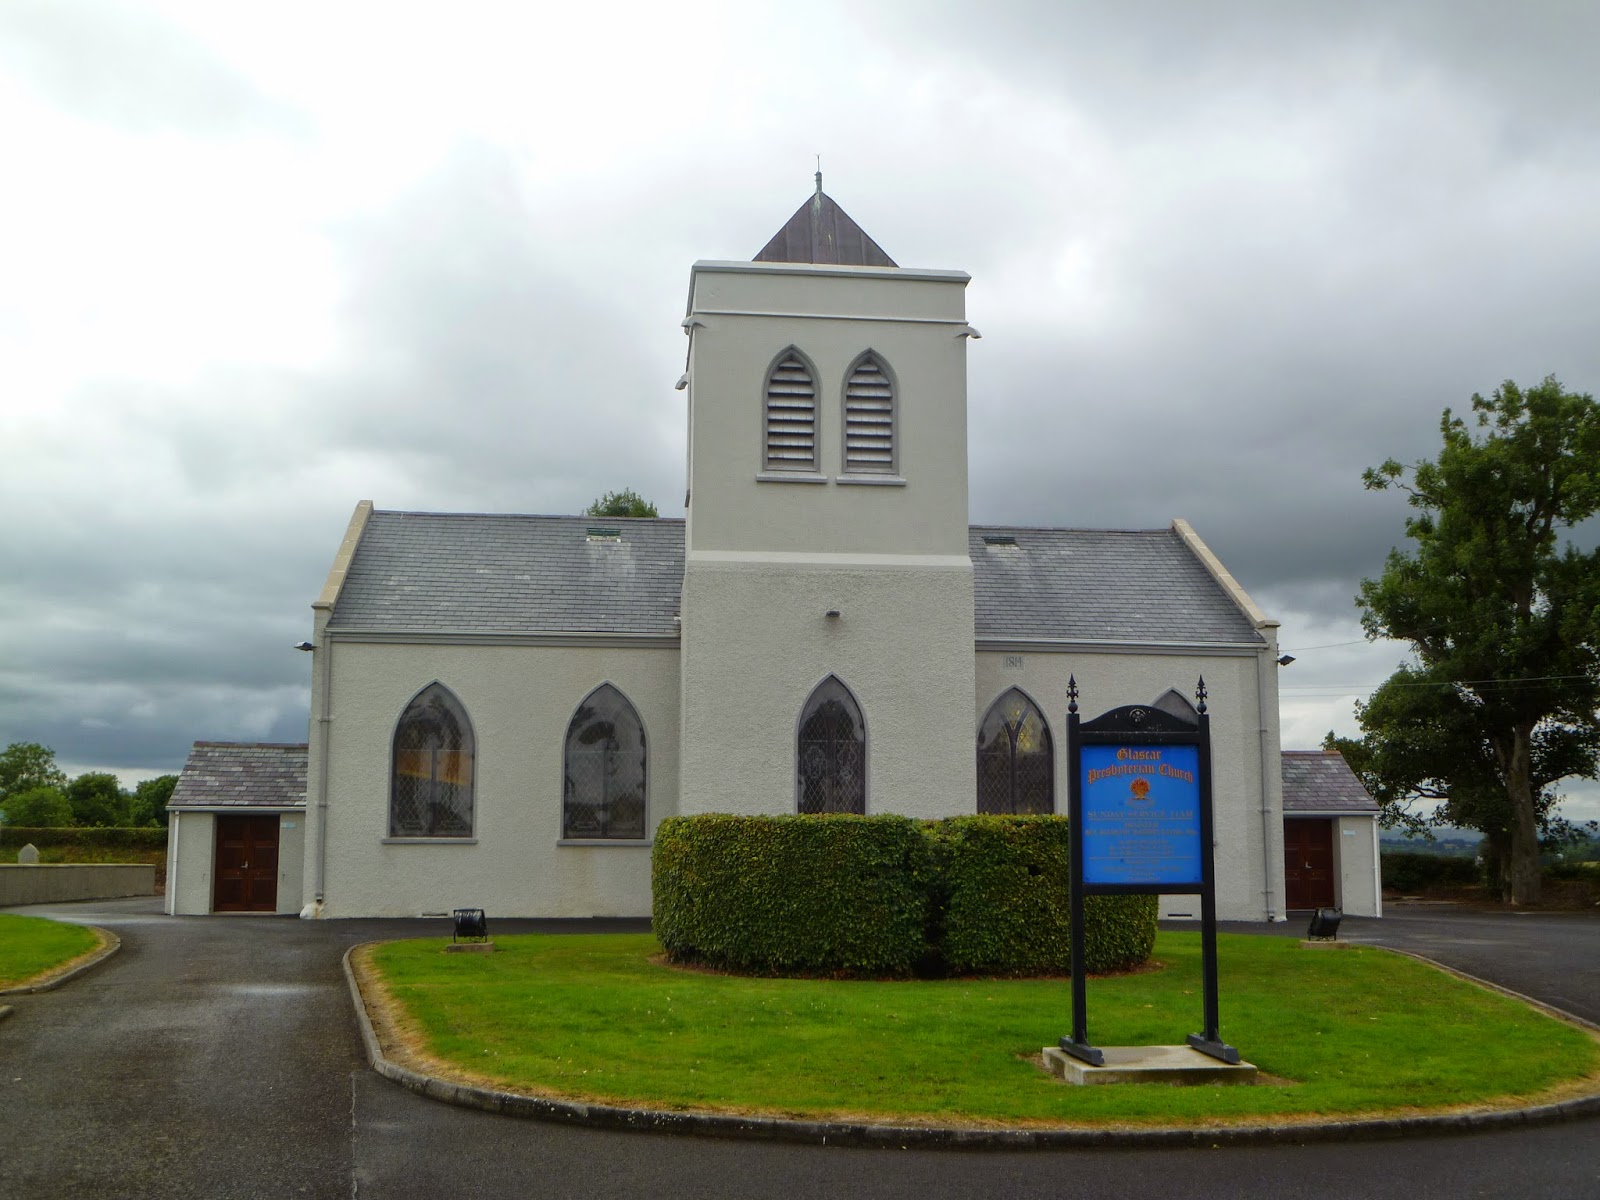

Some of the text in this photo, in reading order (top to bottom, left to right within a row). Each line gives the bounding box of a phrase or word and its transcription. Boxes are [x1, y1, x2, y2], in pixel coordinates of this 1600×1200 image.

[1116, 747, 1162, 760] Glascar
[1087, 763, 1194, 784] Presbyterian Church
